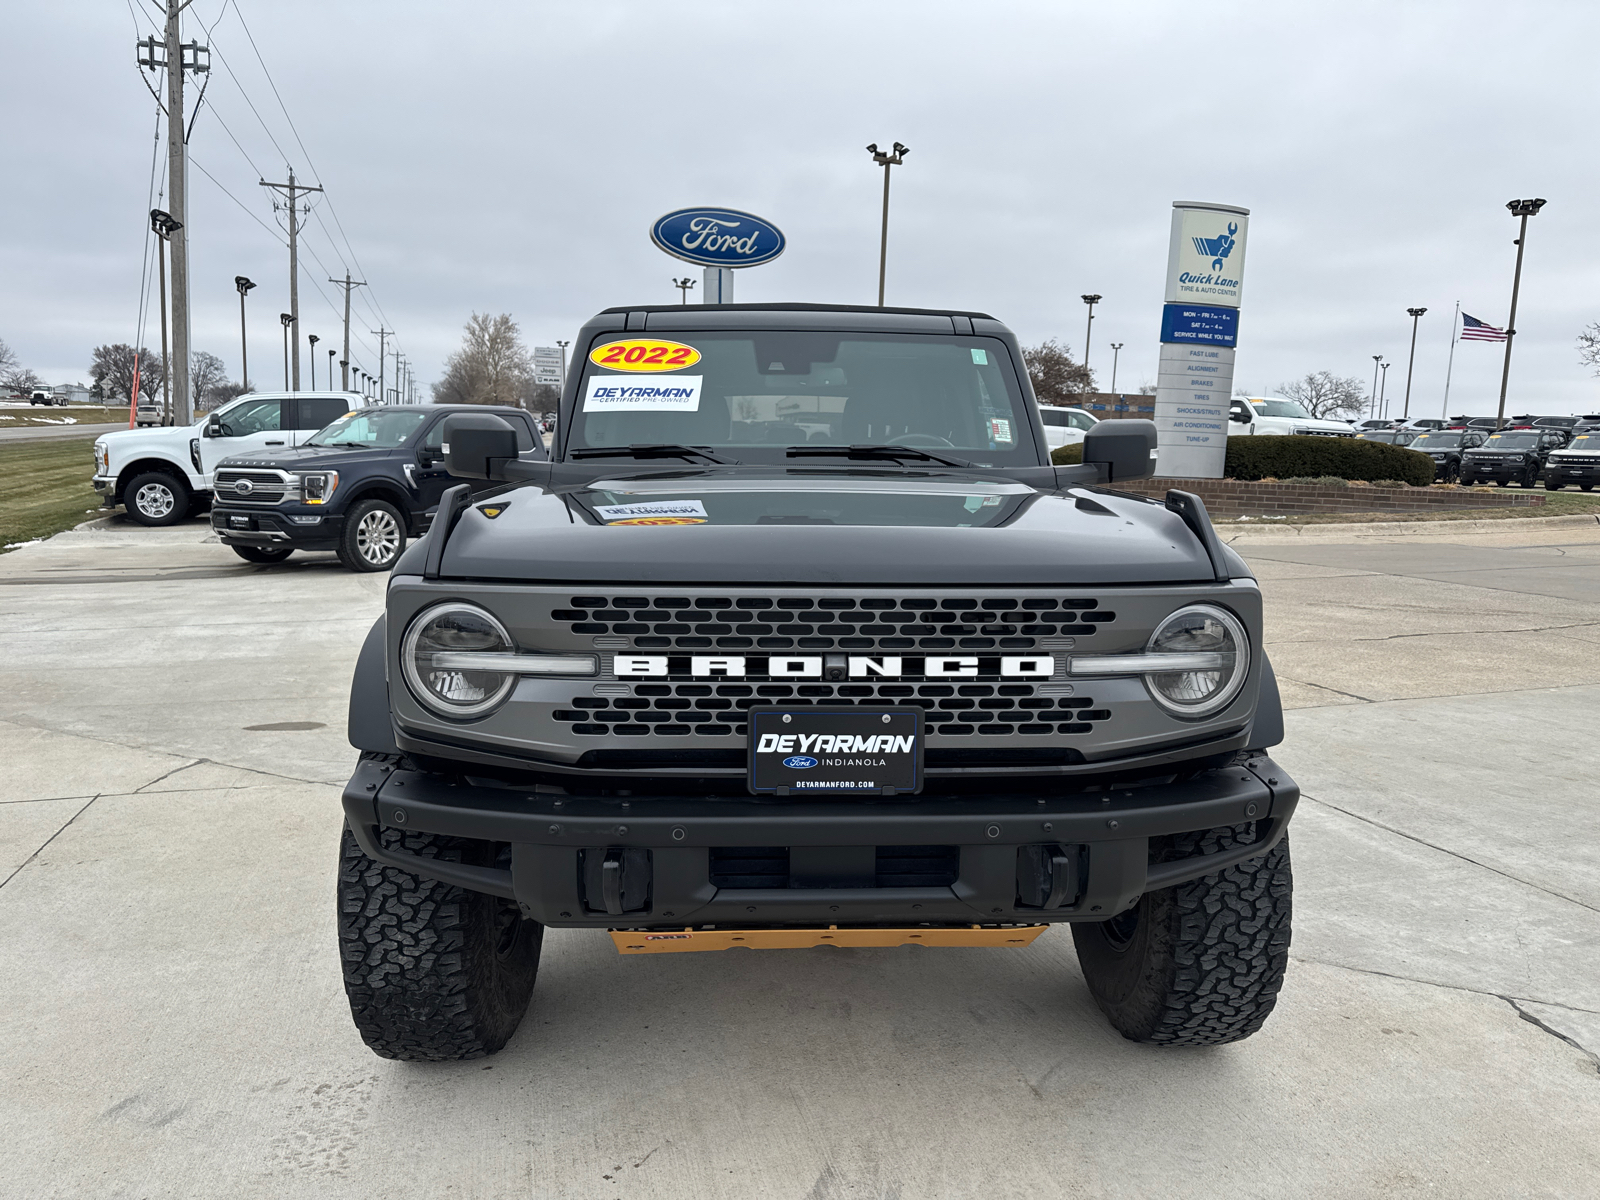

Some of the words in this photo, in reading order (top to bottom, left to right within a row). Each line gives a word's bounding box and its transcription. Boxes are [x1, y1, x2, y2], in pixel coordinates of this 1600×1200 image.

[682, 217, 759, 254] Ford
[1179, 272, 1213, 284] Quick
[1214, 275, 1239, 288] Lane
[1217, 288, 1237, 296] CENTER
[599, 346, 692, 365] 2022
[593, 387, 695, 398] DEYARMAN
[1177, 407, 1221, 415] SHOCKS/STRUTS
[1184, 422, 1222, 430] CONDITIONING
[613, 655, 1055, 677] BRONCO
[756, 734, 915, 753] DEYARMAN
[789, 757, 811, 768] Ford
[821, 758, 887, 766] INDIANOLA
